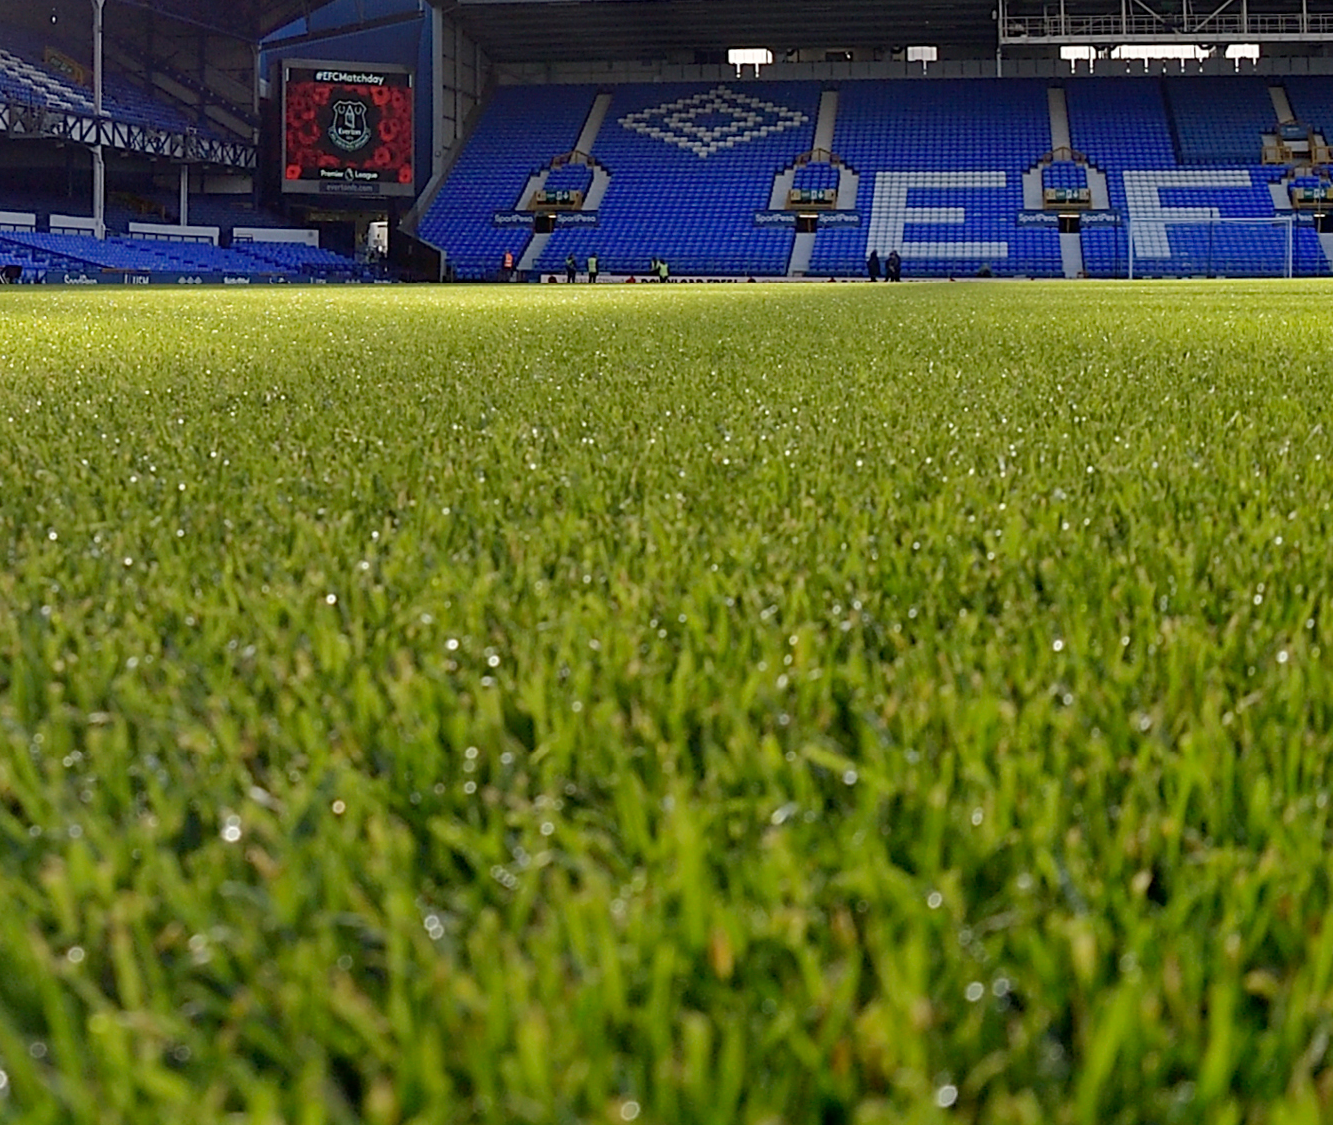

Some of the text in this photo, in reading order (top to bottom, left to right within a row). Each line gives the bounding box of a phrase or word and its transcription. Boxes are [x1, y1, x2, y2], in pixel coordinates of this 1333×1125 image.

[315, 71, 384, 85] #EFCMatchday
[320, 169, 378, 180] Premier League
[866, 171, 1007, 257] E
